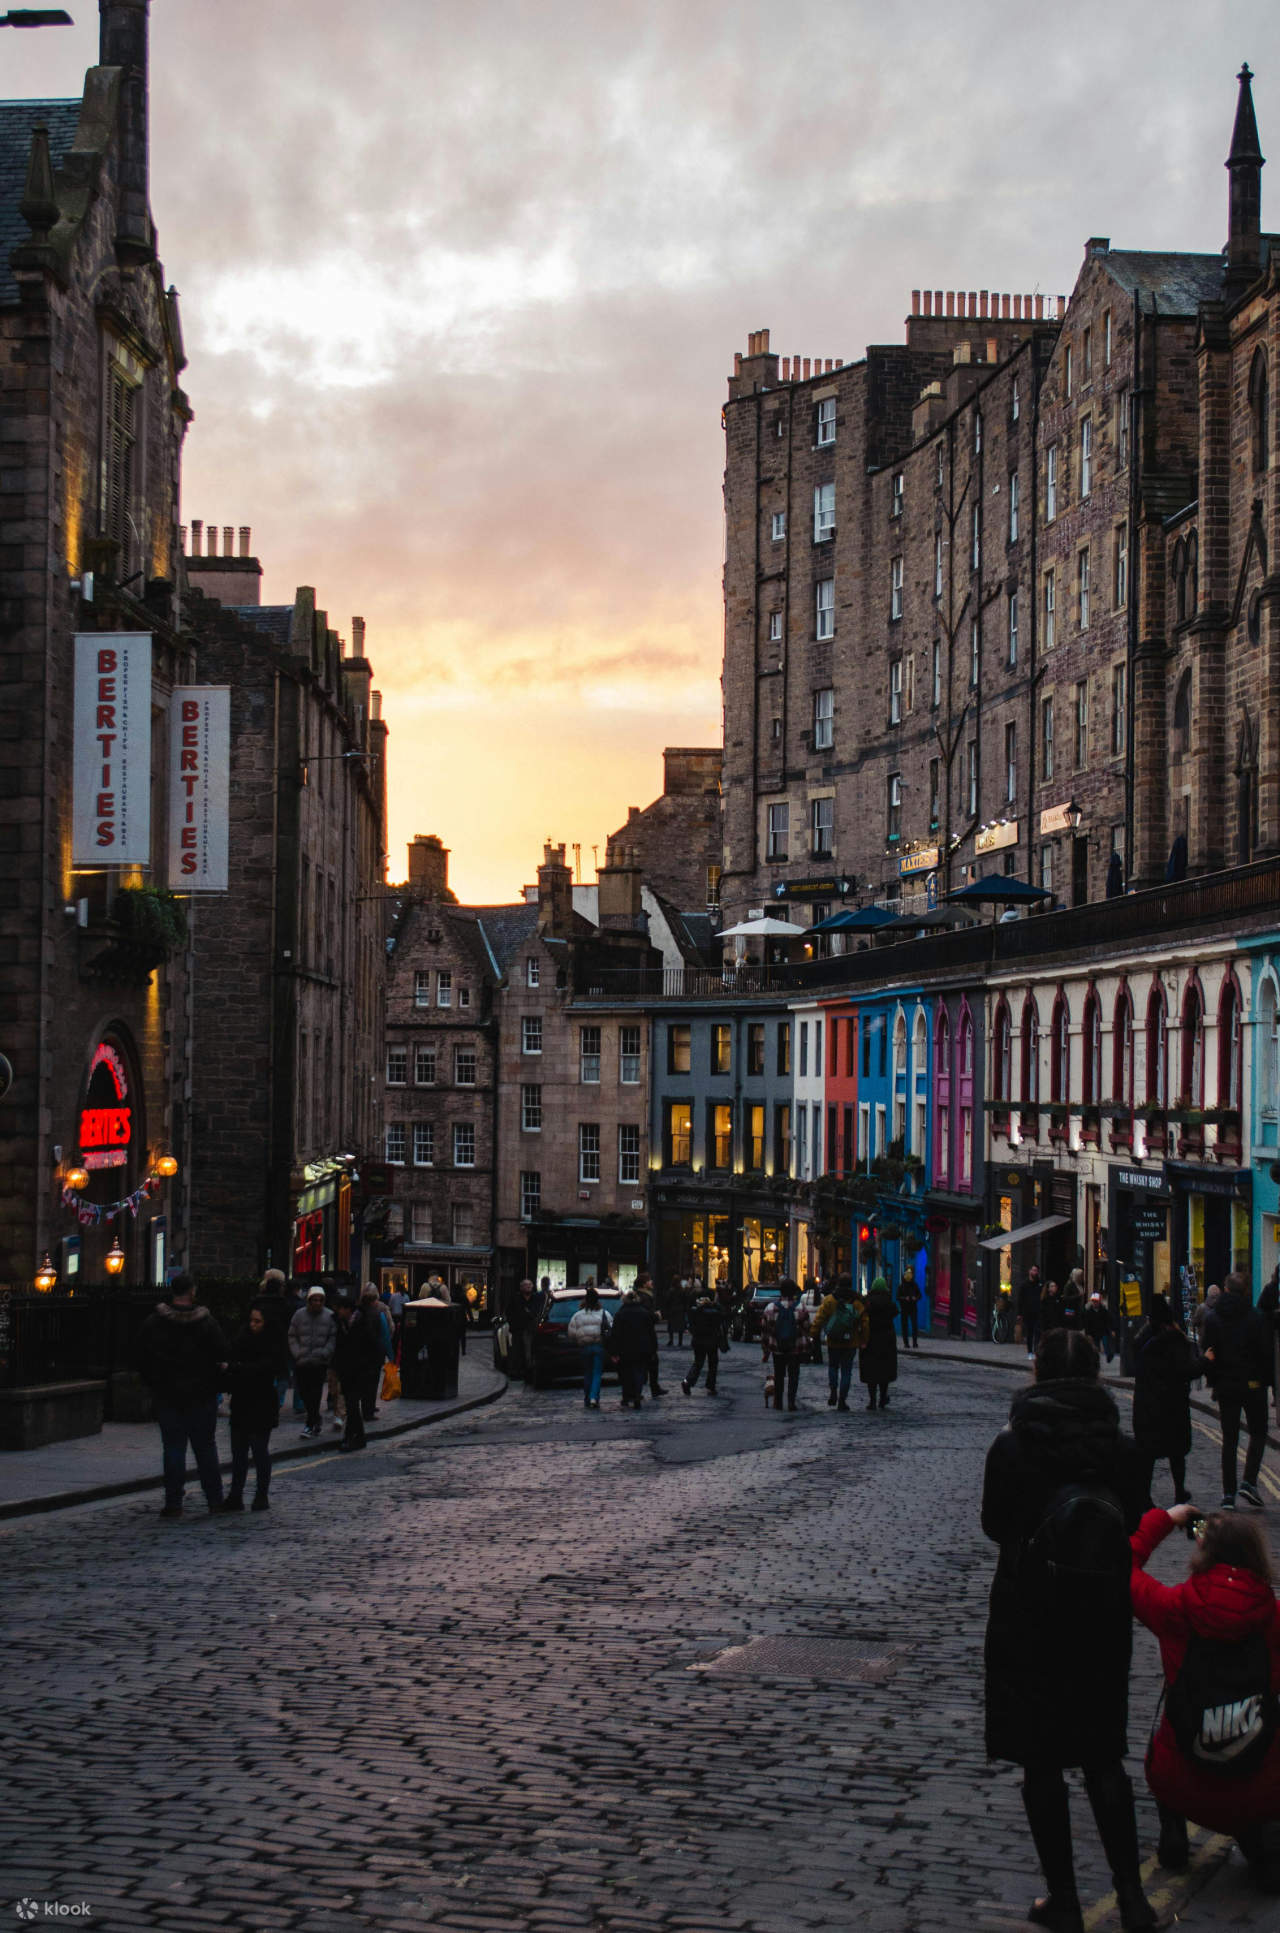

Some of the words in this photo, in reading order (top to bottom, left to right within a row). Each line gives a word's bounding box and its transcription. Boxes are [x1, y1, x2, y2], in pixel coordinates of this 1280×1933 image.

[96, 649, 118, 847] BERTIES
[181, 701, 199, 875] BERTIES
[1118, 1171, 1129, 1184] THE
[1129, 1173, 1148, 1187] WHISKY
[1148, 1175, 1162, 1189] SHOP
[1202, 1694, 1264, 1744] NIKE
